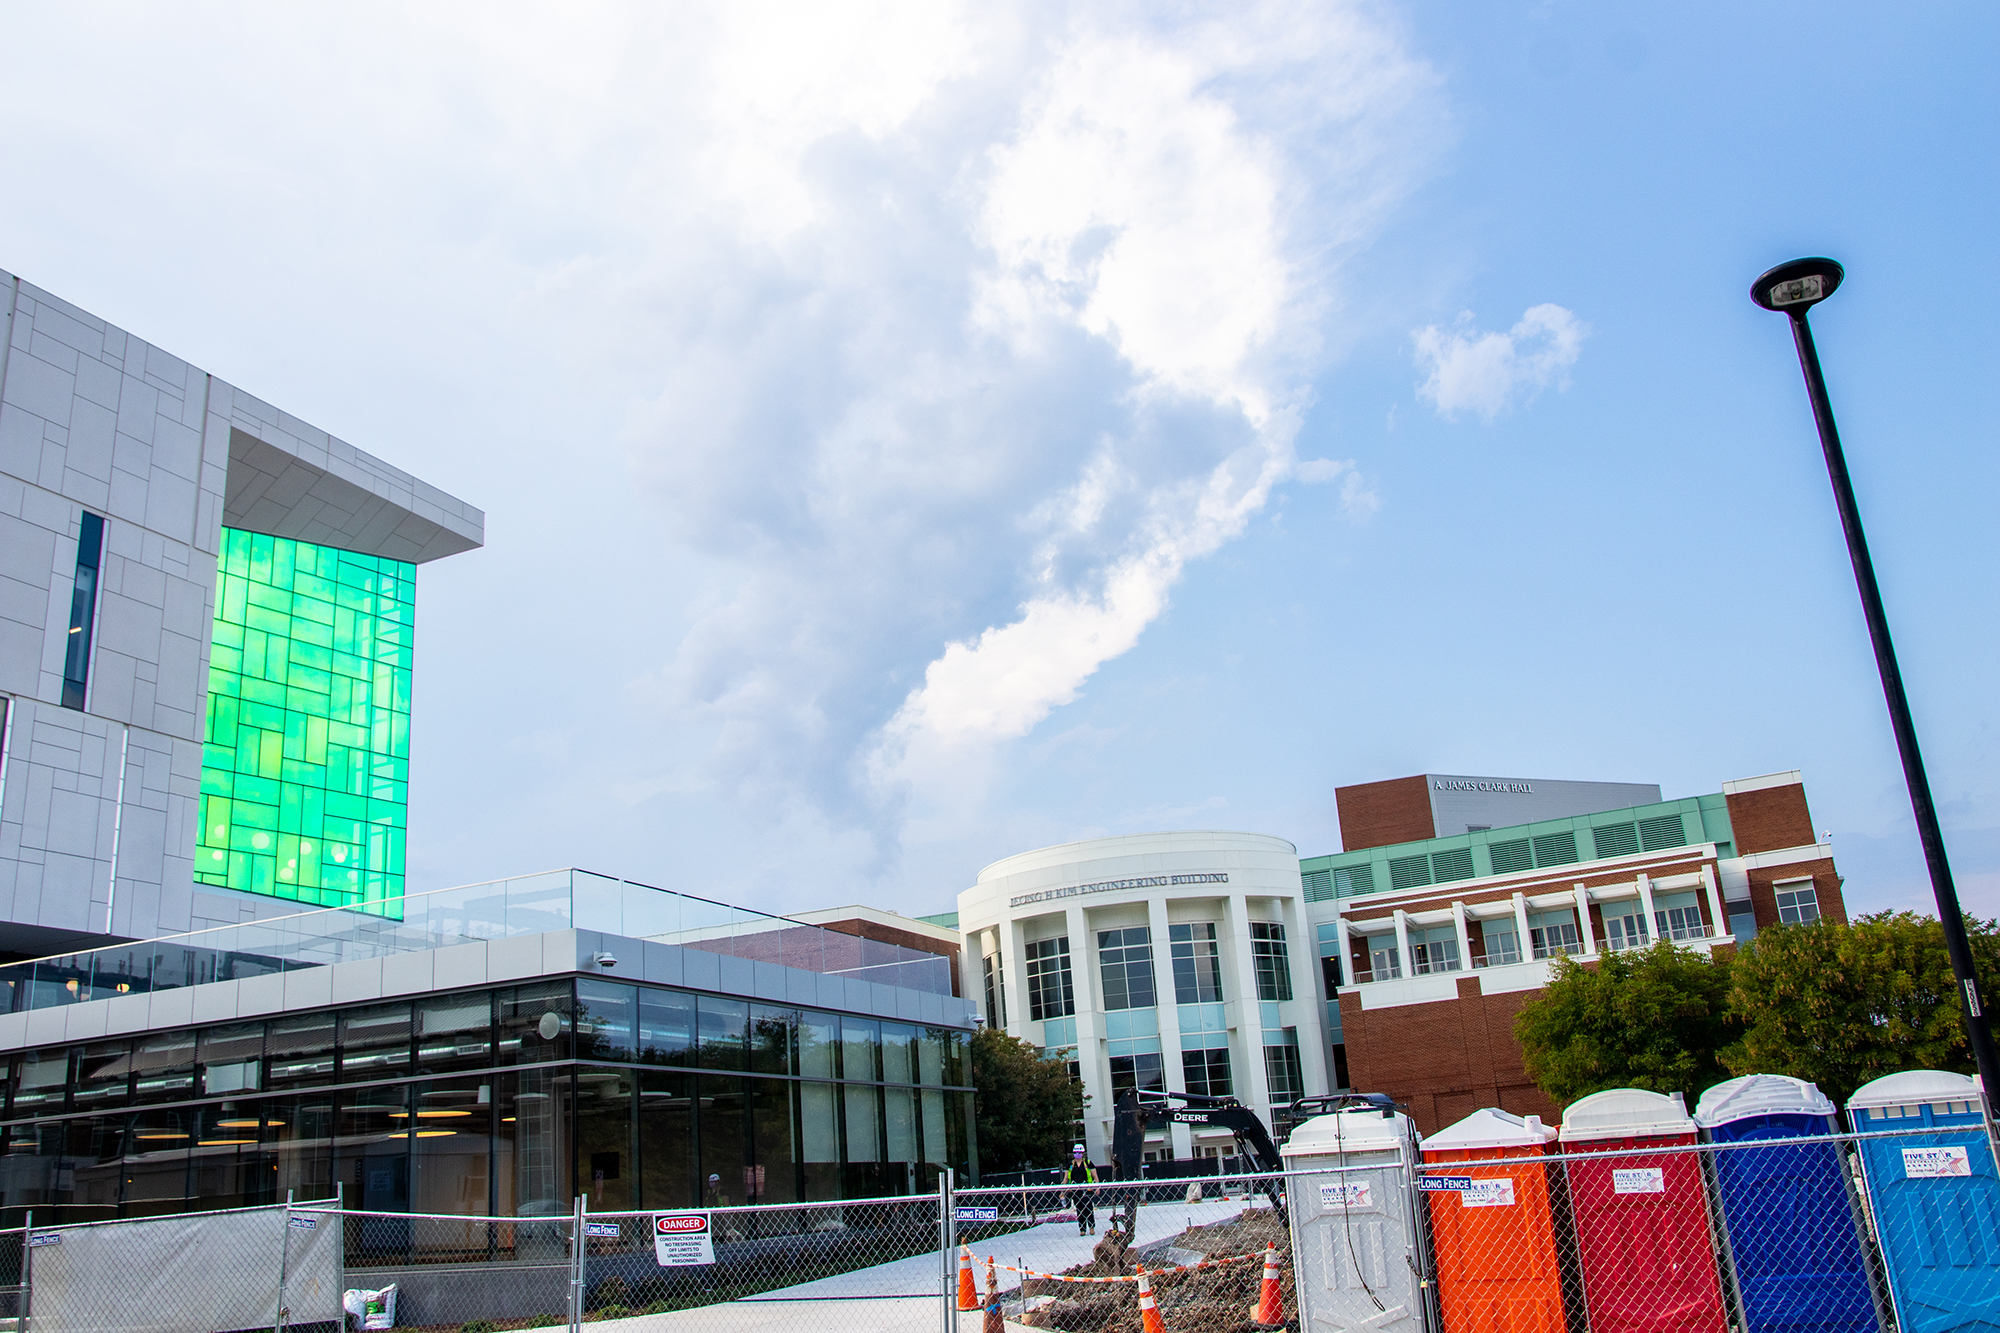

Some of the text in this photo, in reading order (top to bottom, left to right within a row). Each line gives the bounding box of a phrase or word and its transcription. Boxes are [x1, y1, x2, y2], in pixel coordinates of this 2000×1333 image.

[1446, 781, 1476, 790] JAMES
[1478, 782, 1508, 792] CLARK
[1510, 783, 1534, 793] HALL
[1056, 886, 1077, 898] KIM
[1081, 876, 1167, 894] ENGINEERING
[1171, 873, 1228, 885] BUILDING
[1174, 1113, 1208, 1122] DEERE
[1420, 1177, 1443, 1189] LONG
[1443, 1177, 1470, 1189] FENCE
[956, 1209, 996, 1219] LONG FENCE
[663, 1219, 700, 1229] DANGER
[588, 1225, 618, 1235] LONG FENCE
